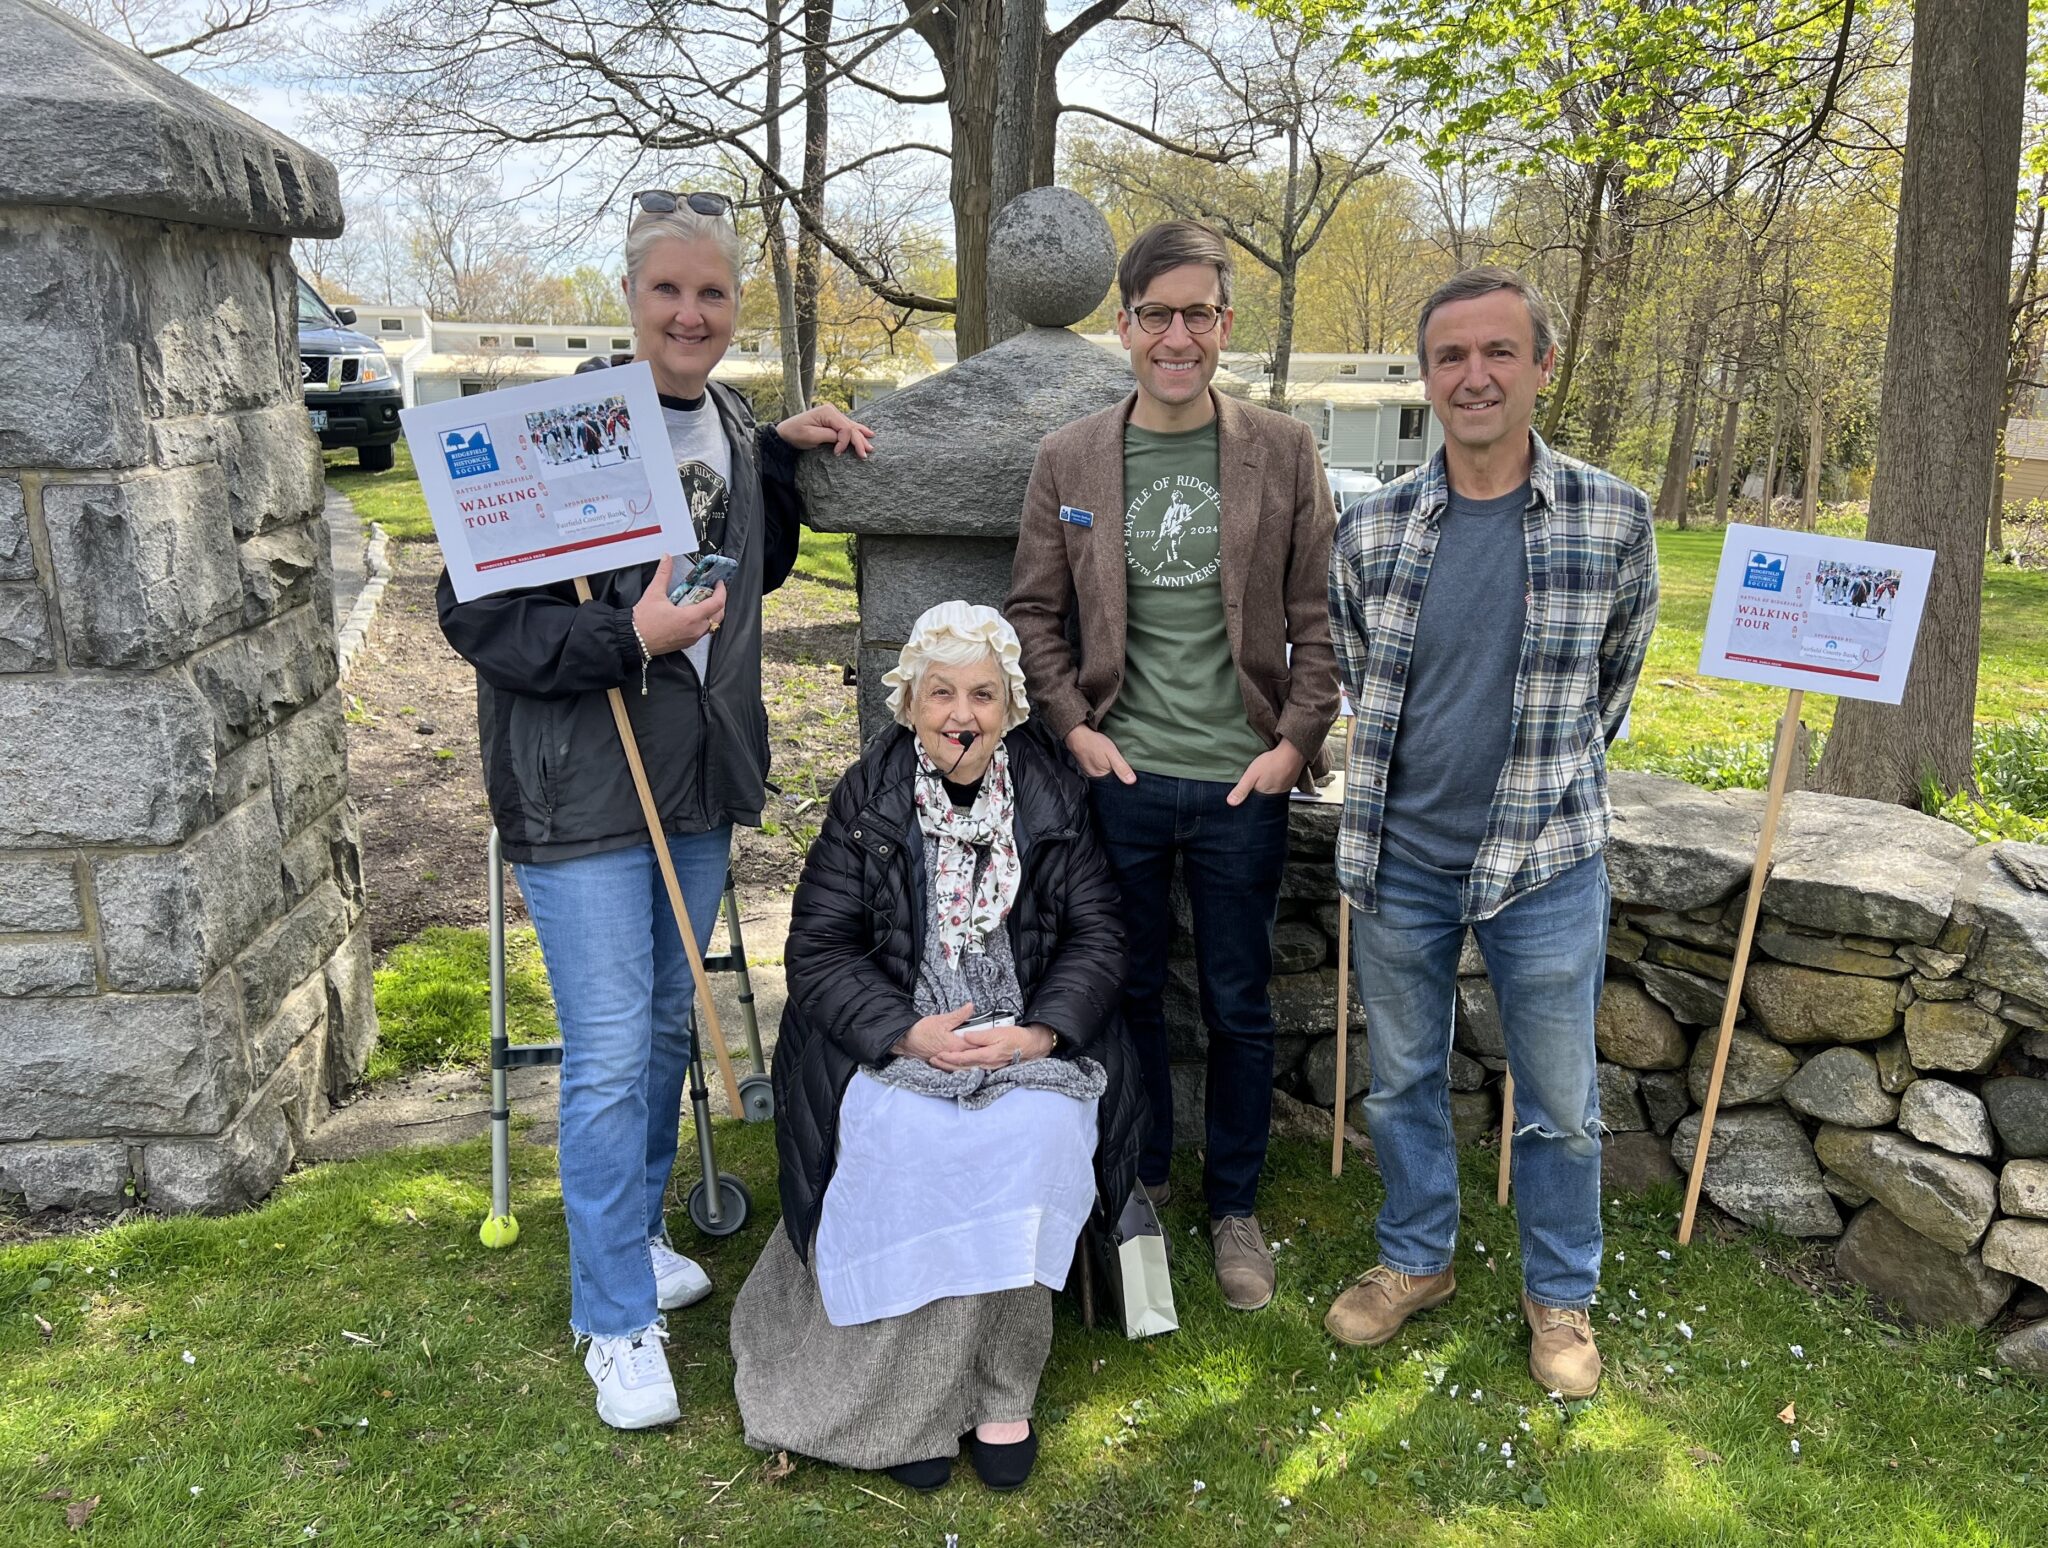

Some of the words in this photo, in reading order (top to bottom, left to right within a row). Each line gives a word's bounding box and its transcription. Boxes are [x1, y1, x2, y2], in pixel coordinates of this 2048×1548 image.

[451, 447, 488, 460] RIDGEFIELD
[453, 455, 491, 468] HISTORICAL
[455, 463, 493, 475] SOCIETY
[679, 466, 690, 478] OF
[456, 486, 482, 495] BATTLE
[494, 474, 534, 487] RIDGEFIELD
[460, 487, 537, 512] WALKING
[1124, 488, 1152, 537] BATTLE
[1152, 476, 1170, 491] OF
[465, 510, 510, 529] TOUR
[556, 518, 583, 529] Fairfield
[583, 513, 606, 523] County
[1136, 530, 1156, 538] 1777
[1190, 525, 1218, 535] 2024
[1748, 580, 1777, 589] SOCIETY
[1738, 604, 1799, 621] WALKING
[1735, 617, 1770, 630] TOUR
